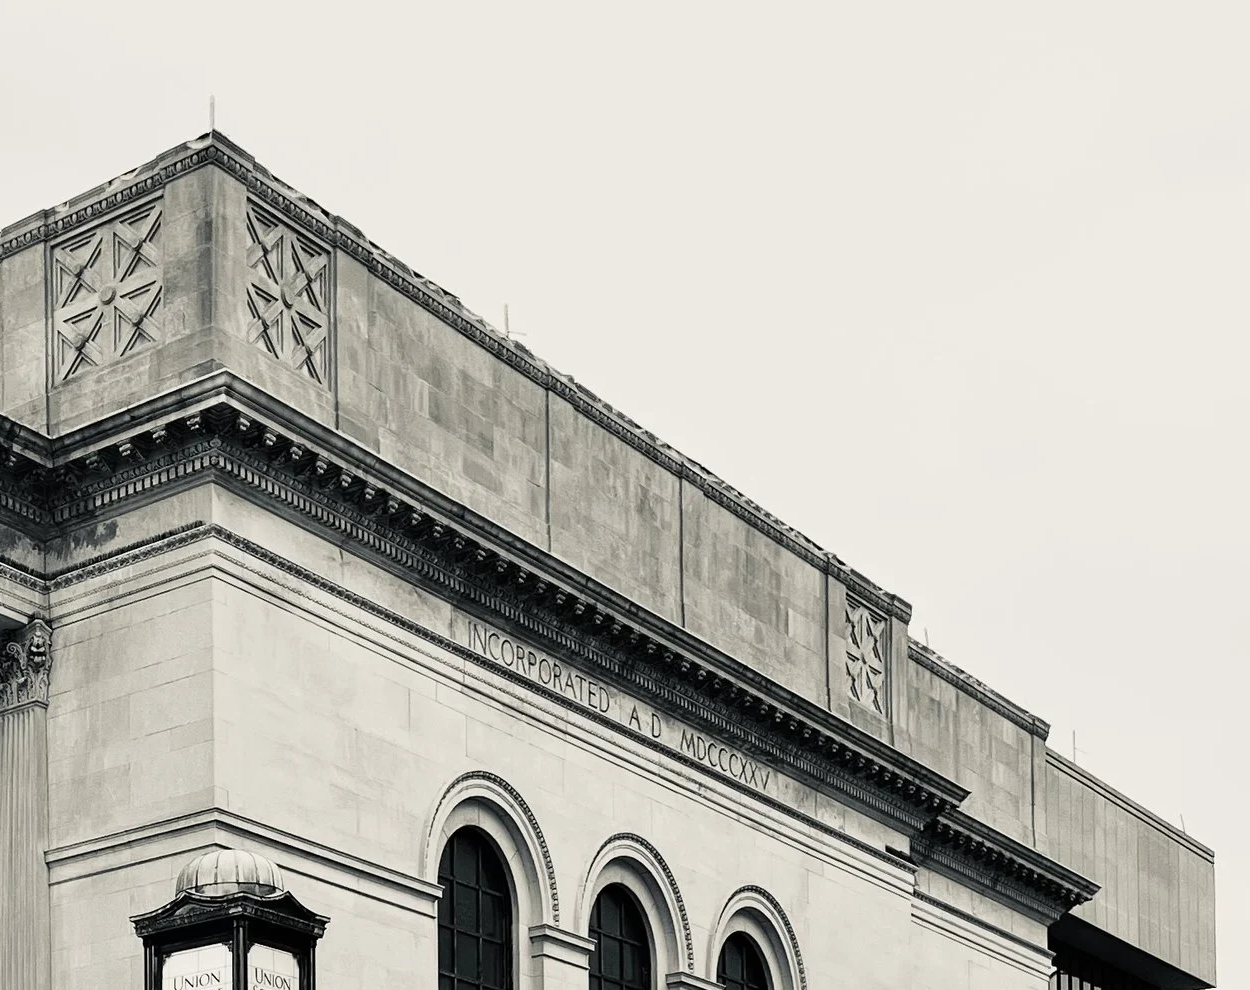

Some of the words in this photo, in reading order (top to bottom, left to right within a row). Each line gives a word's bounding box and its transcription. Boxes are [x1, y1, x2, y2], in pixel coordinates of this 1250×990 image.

[467, 620, 610, 713] INCORPORATED
[628, 704, 642, 731] A
[651, 712, 662, 739] D
[680, 728, 771, 790] MDCCCXXV
[254, 967, 291, 990] UNION
